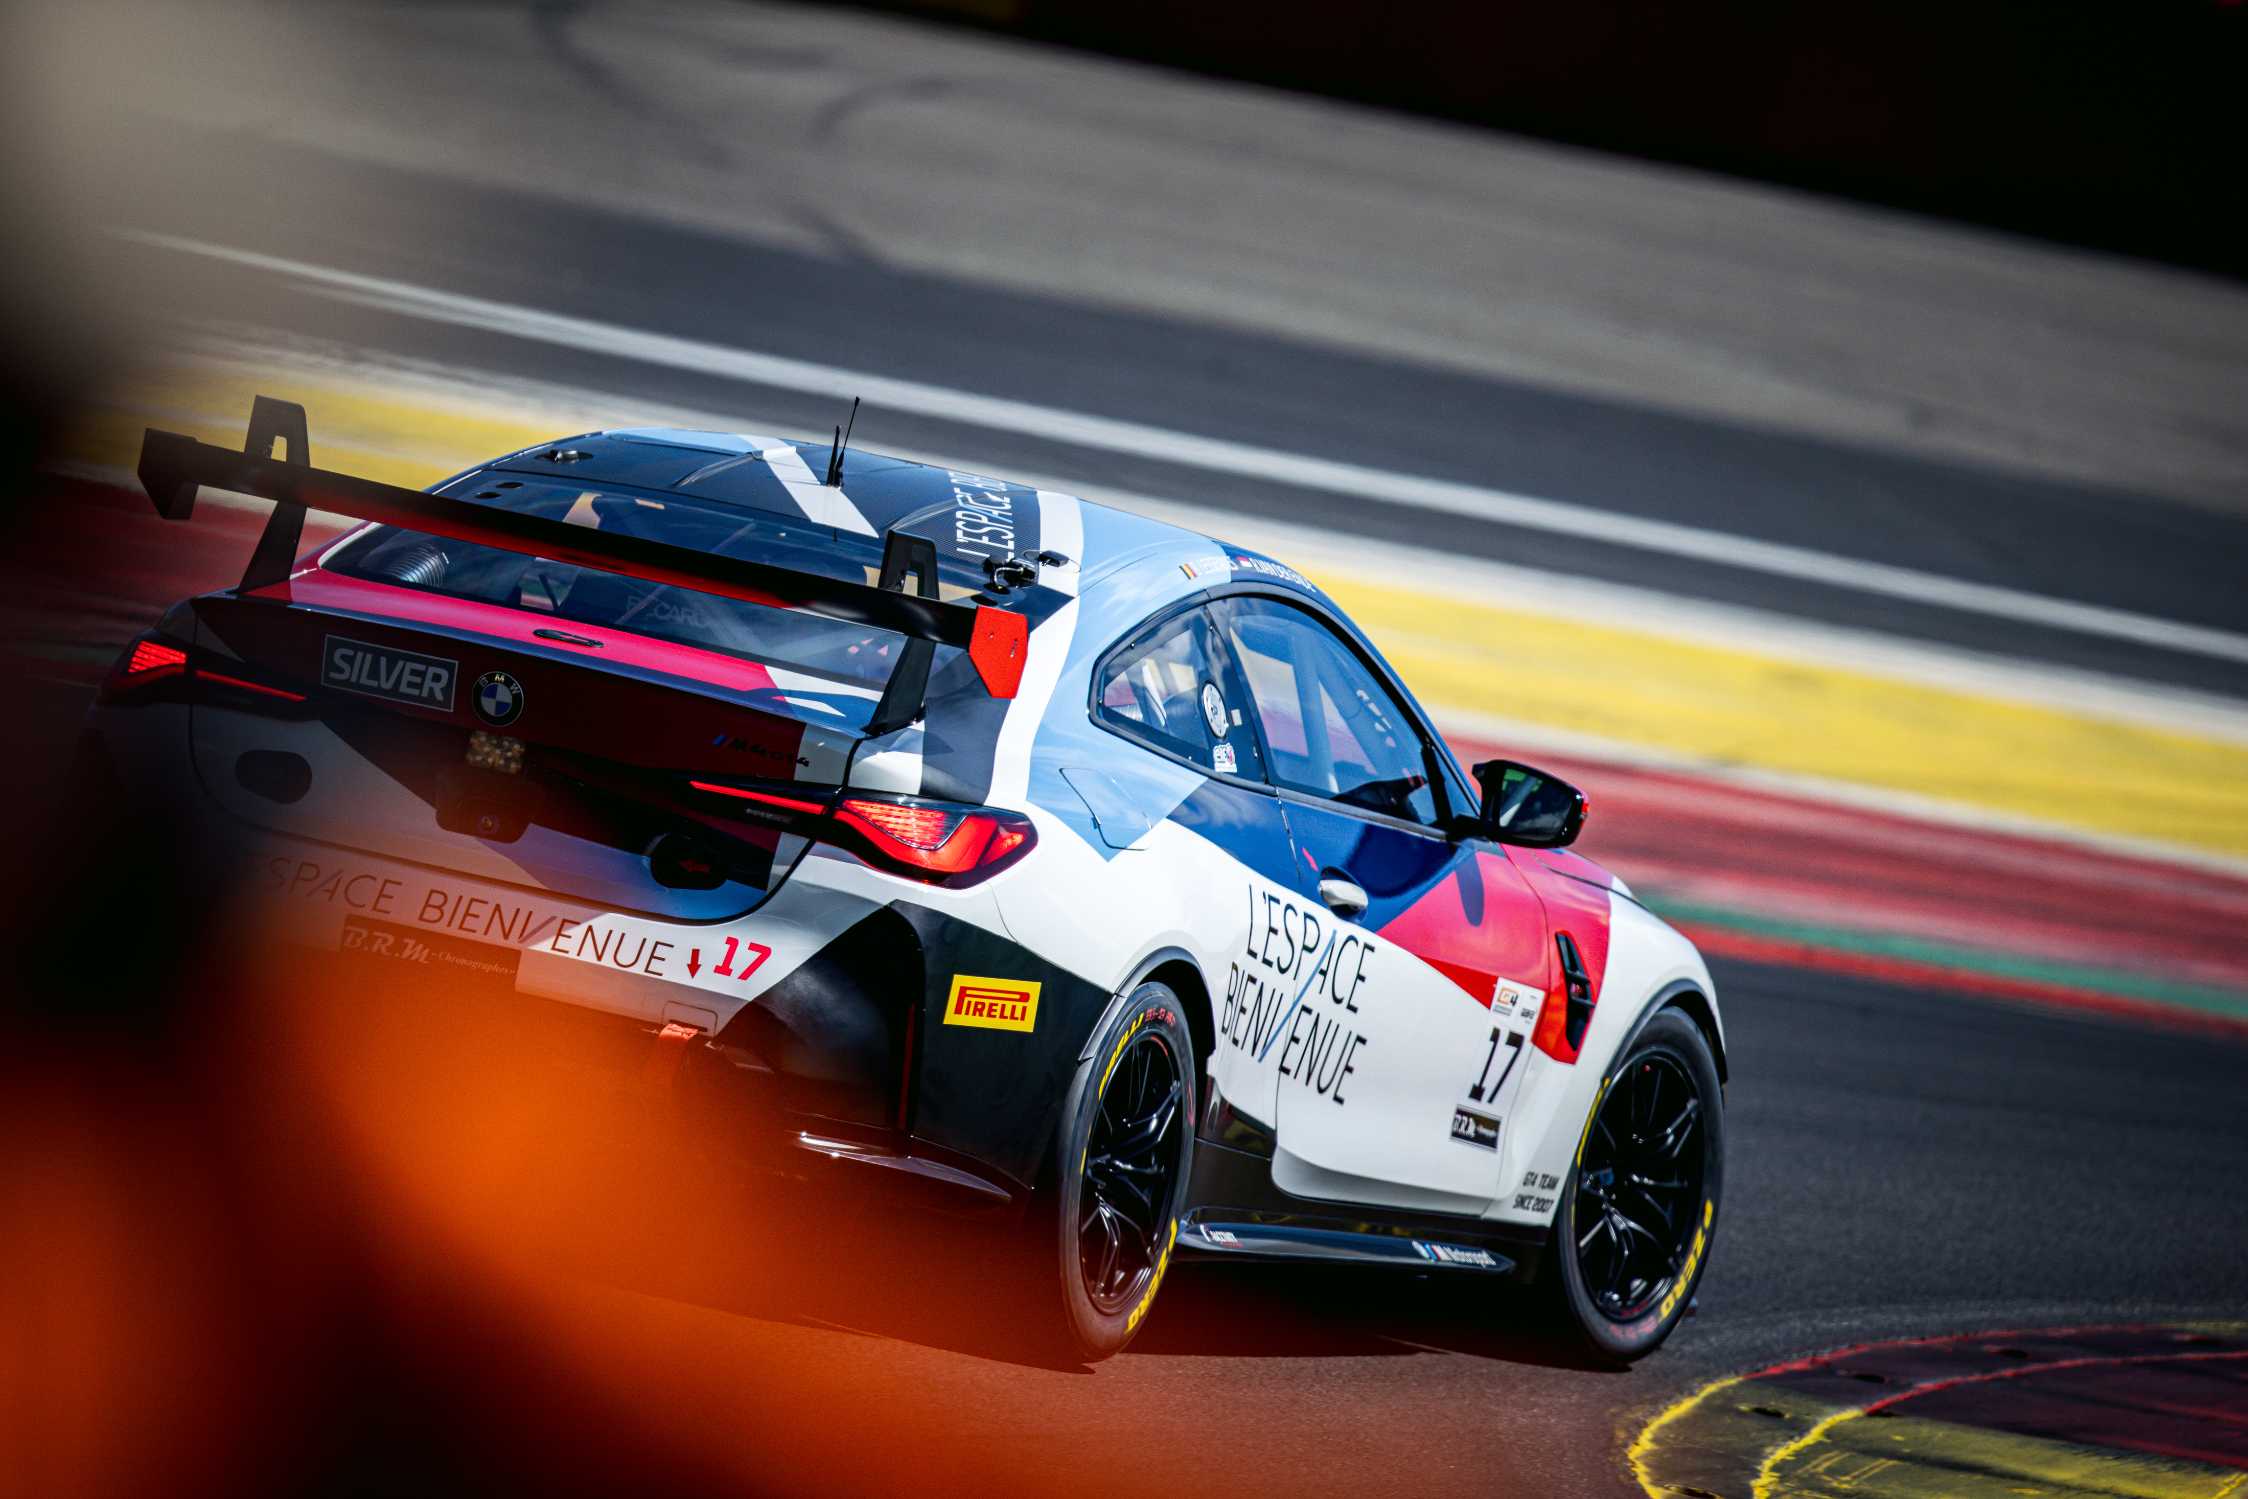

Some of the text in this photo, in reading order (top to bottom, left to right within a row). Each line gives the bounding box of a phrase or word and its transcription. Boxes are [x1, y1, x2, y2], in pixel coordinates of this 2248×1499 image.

[328, 647, 450, 701] SILVER
[418, 887, 675, 978] BIENVENUE
[713, 936, 773, 982] 17
[1246, 883, 1376, 1015] L'ESPACE
[953, 985, 1031, 1022] PIRELLI
[1221, 960, 1368, 1106] BIENVENUE
[1468, 1026, 1525, 1104] 17
